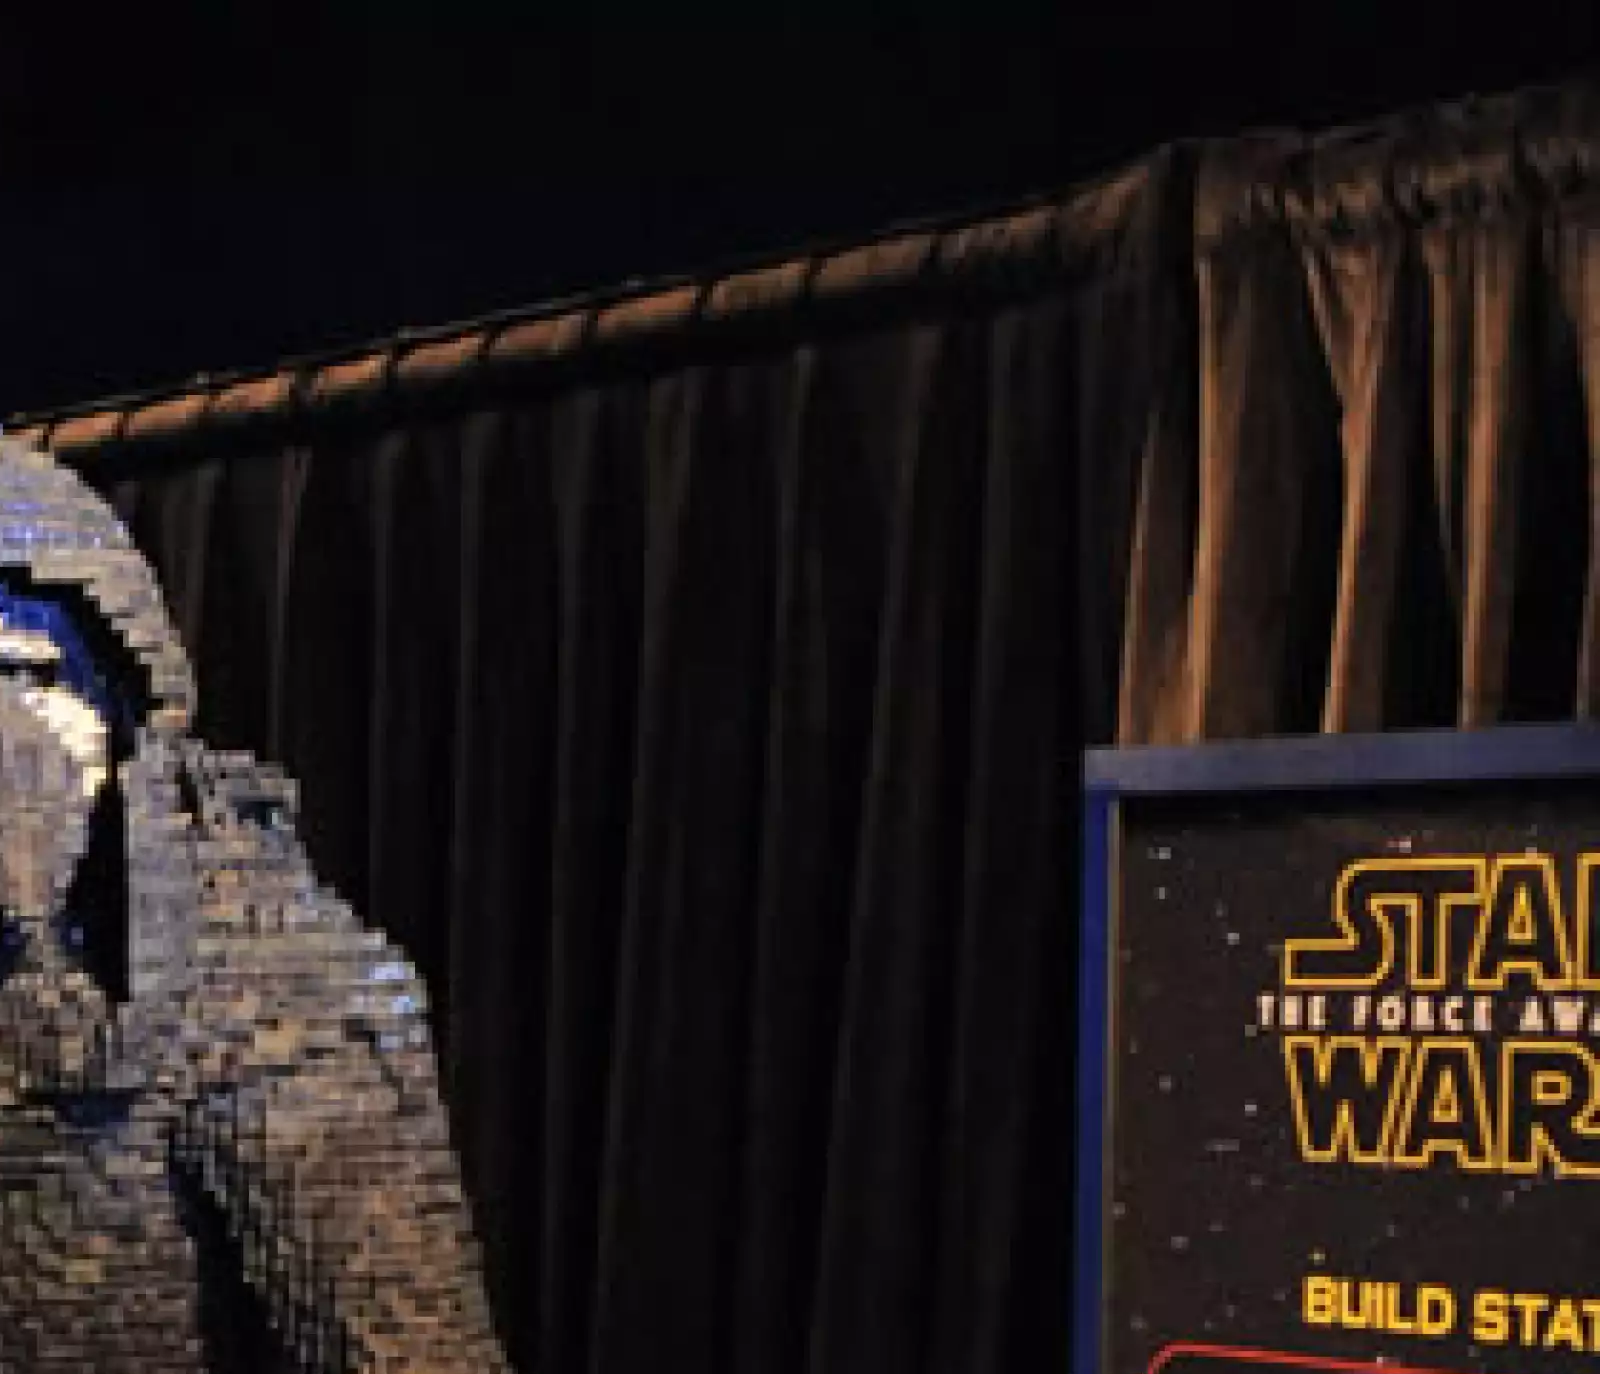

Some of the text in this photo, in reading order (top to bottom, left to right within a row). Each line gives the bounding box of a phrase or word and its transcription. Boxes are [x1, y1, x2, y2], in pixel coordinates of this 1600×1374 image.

[1284, 852, 1600, 990] STA
[1257, 995, 1326, 1028] THE
[1353, 996, 1492, 1032] FORCE
[1302, 1275, 1456, 1335] BUILD
